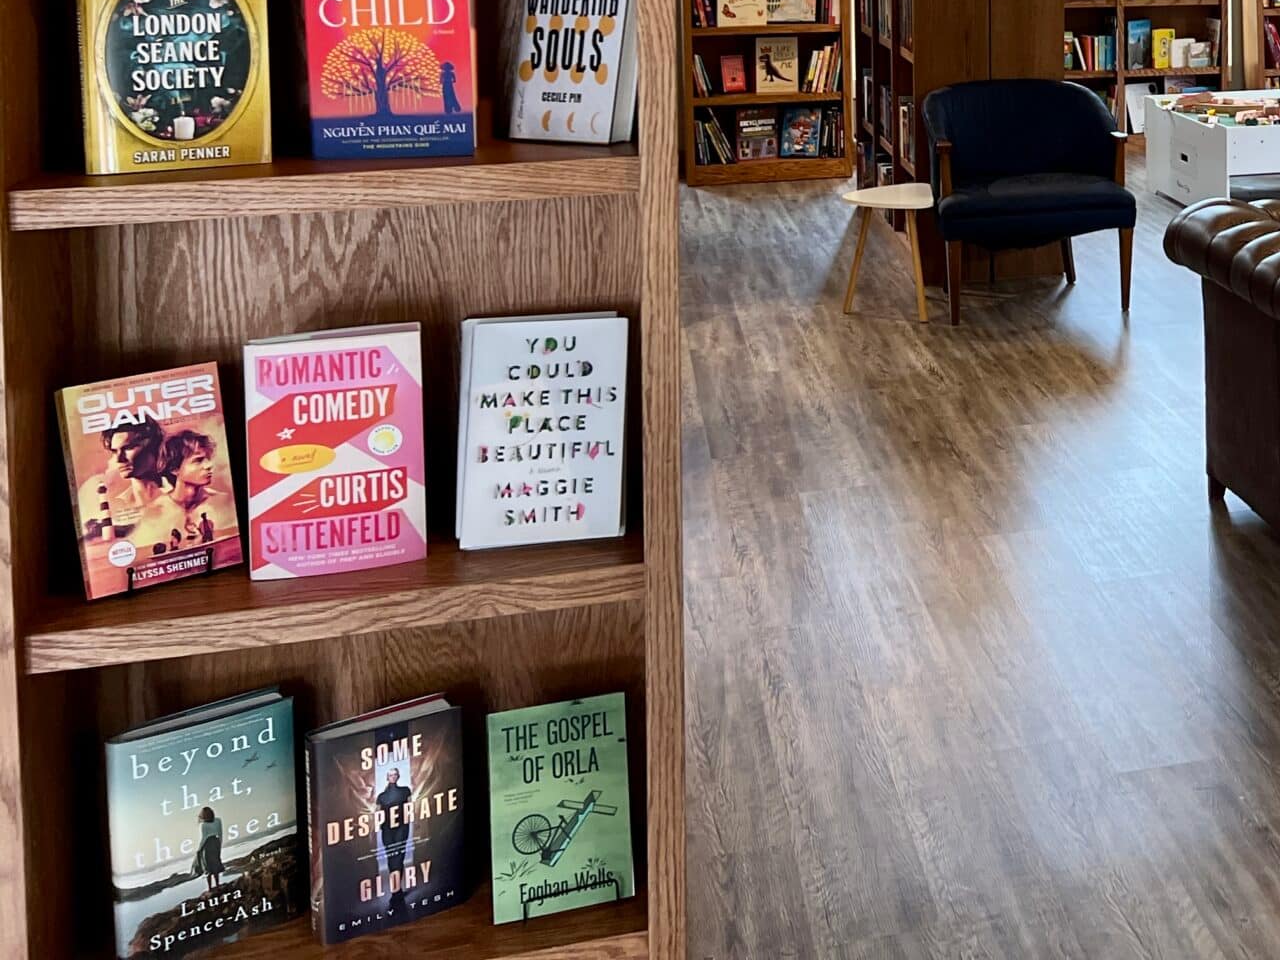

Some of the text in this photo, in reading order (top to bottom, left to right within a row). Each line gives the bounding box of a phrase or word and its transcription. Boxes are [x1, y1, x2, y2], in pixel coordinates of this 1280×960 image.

[132, 12, 222, 37] LONDON
[136, 38, 220, 64] SÉANCE
[531, 26, 604, 73] SOULS
[132, 66, 224, 92] SOCIETY
[541, 91, 582, 104] CECILE PIN
[378, 125, 411, 136] PHAN
[443, 123, 466, 134] MAI
[133, 146, 230, 164] SARAH PENNER
[526, 335, 577, 355] YOU
[259, 349, 382, 387] ROMANTIC
[508, 360, 593, 381] COULD
[77, 374, 215, 415] OUTER
[293, 387, 390, 425] COMEDY
[480, 386, 617, 409] MAKE THIS
[81, 393, 217, 435] BANKS
[508, 415, 587, 434] PLACE
[477, 440, 615, 463] BEAUTIFUL
[320, 469, 403, 508] CURTIS
[495, 478, 594, 499] MAGGIE
[266, 511, 400, 554] SITTENFELD
[504, 503, 585, 526] SMITH
[132, 567, 165, 582] ALYSSA
[130, 717, 276, 780] beyond
[501, 711, 614, 754] THE GOSPEL
[361, 733, 422, 771] SOME
[522, 746, 600, 784] OF ORLA
[160, 776, 252, 816] that,
[327, 788, 458, 846] DESPERATE
[133, 811, 281, 869] the sea
[360, 860, 432, 903] GLORY
[520, 867, 614, 906] Eoghan Walls
[180, 890, 242, 918] Laura
[338, 890, 454, 932] EMILY TESH
[150, 896, 273, 951] Spence-Ash
